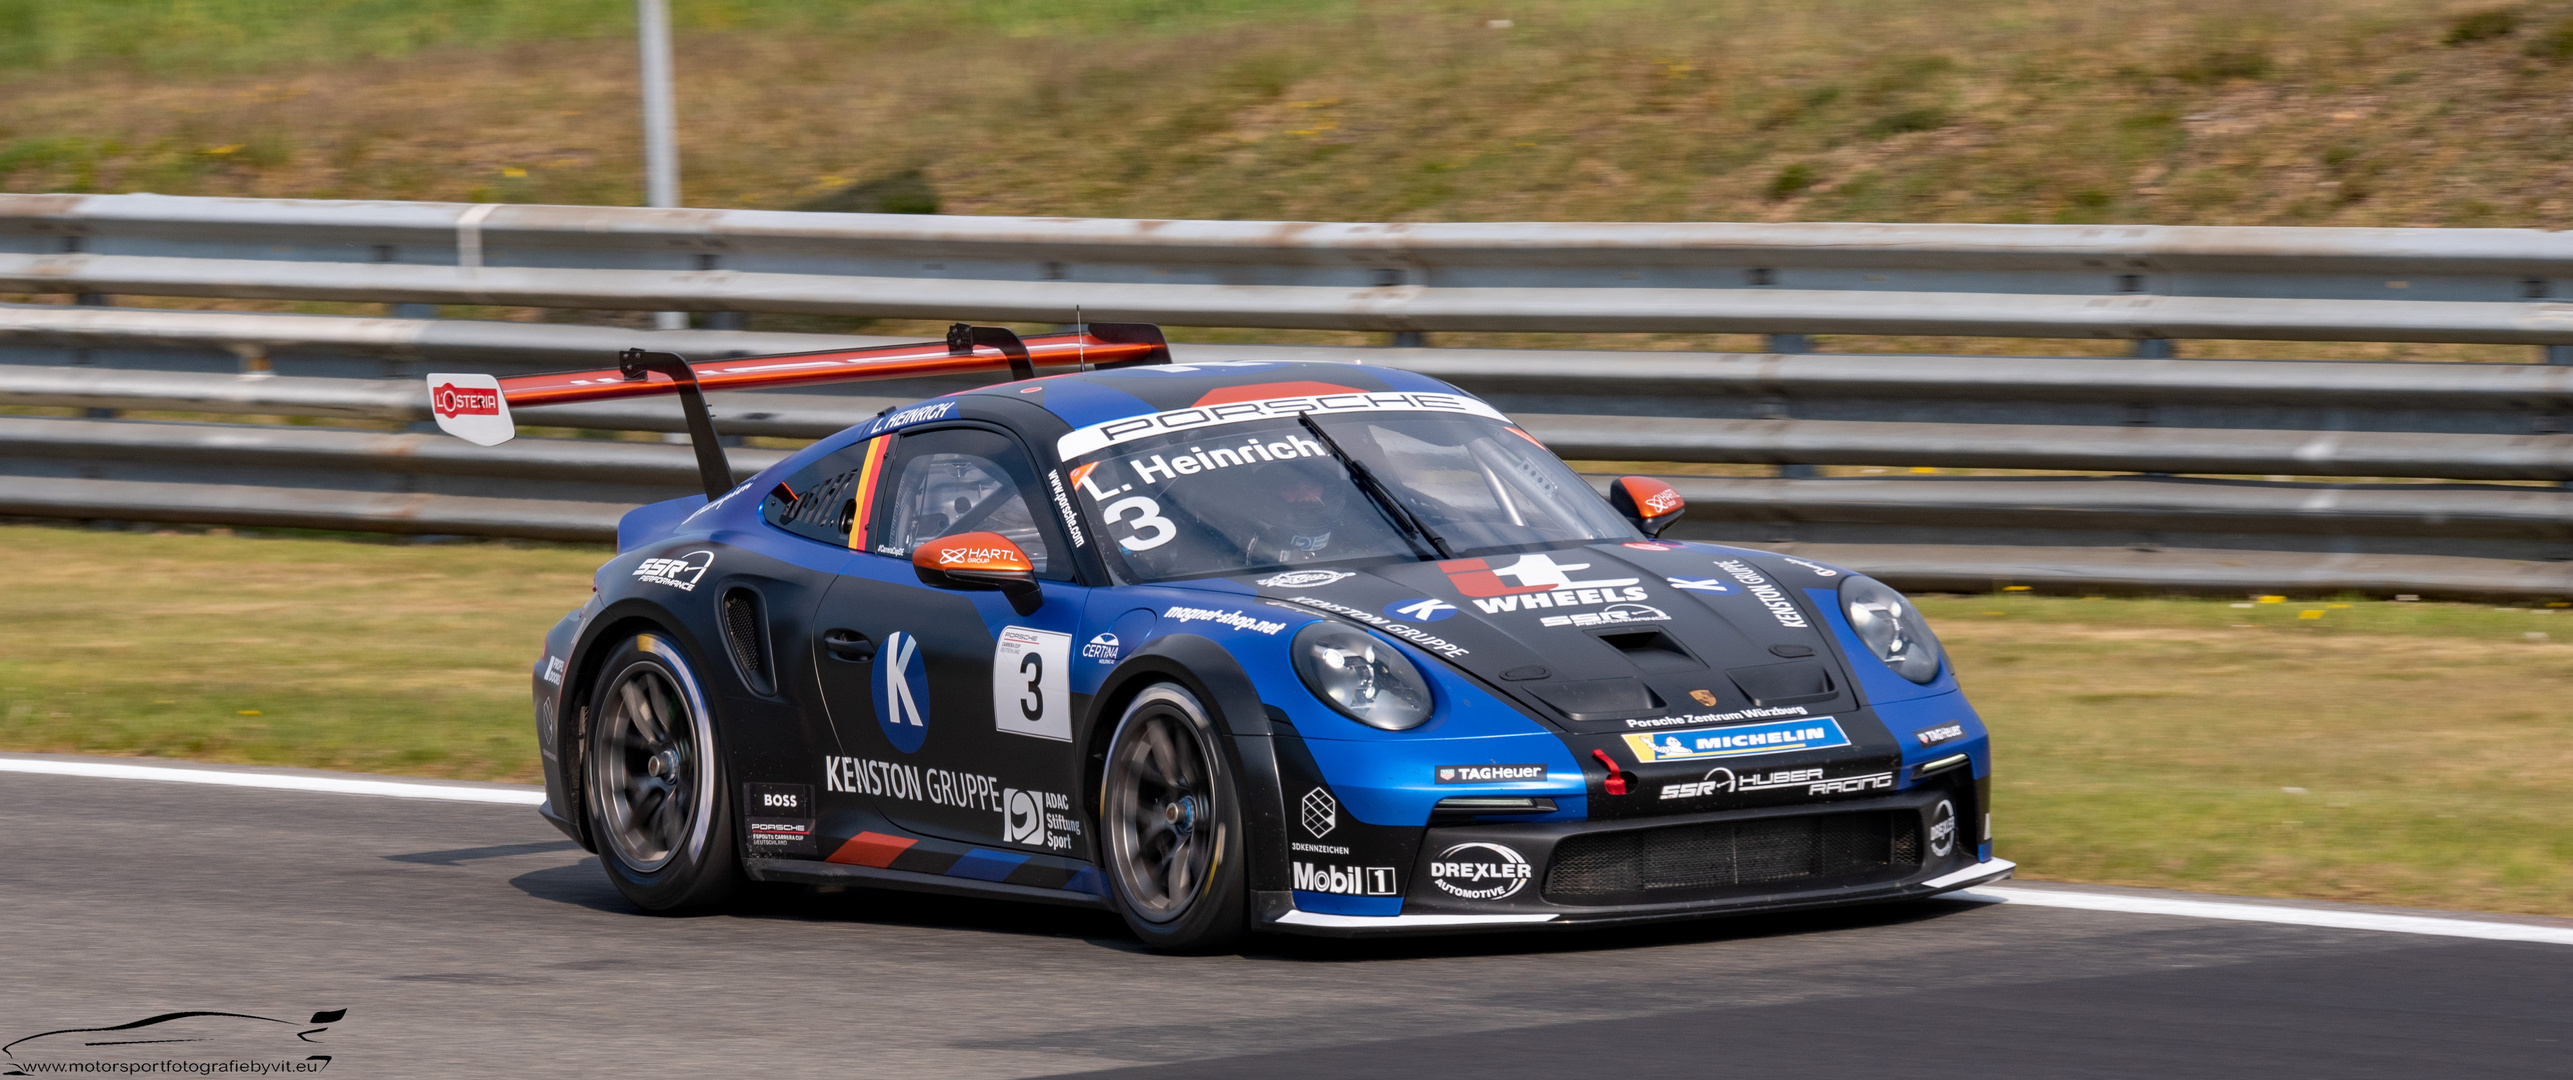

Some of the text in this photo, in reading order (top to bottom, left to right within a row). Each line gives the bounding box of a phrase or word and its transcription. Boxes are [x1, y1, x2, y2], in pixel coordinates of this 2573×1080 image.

[871, 402, 955, 434] L. HEINRICH
[1099, 394, 1466, 441] PORSCHE
[1080, 434, 1325, 502] L. Heinrich
[1048, 468, 1085, 549] www.porsche.com
[1103, 496, 1177, 551] 3
[968, 547, 1019, 563] HARTL
[637, 575, 696, 592] PERFORMANCE
[1712, 559, 1766, 585] GRUPPE
[1397, 598, 1458, 621] K
[1471, 586, 1648, 615] WHEELS
[1747, 584, 1808, 628] KENSTON
[1163, 606, 1287, 635] magnet-shop.net
[1004, 631, 1038, 642] PORSCHE
[1385, 622, 1470, 659] GRUPPE
[1082, 643, 1120, 660] CERTINA
[886, 630, 924, 727] K
[1020, 652, 1043, 721] 3
[1625, 705, 1808, 728] Porsche Zentrum Würzburg
[1695, 726, 1826, 750] MICHELIN
[825, 755, 1003, 812] KENSTON GRUPPE
[1738, 768, 1824, 787] HUBER
[1808, 775, 1893, 796] RACING
[763, 793, 797, 807] BOSS
[1045, 792, 1069, 810] ADAC
[1659, 780, 1718, 800] SSR
[751, 823, 805, 832] PORSCHE
[1046, 812, 1081, 836] Stiftung
[1047, 830, 1072, 851] Sport
[1291, 842, 1350, 855] 3DKENNZEICHEN
[1293, 861, 1387, 895] Mobil 1
[1430, 862, 1532, 882] DREXLER
[1434, 878, 1505, 899] AUTOMOTIVE
